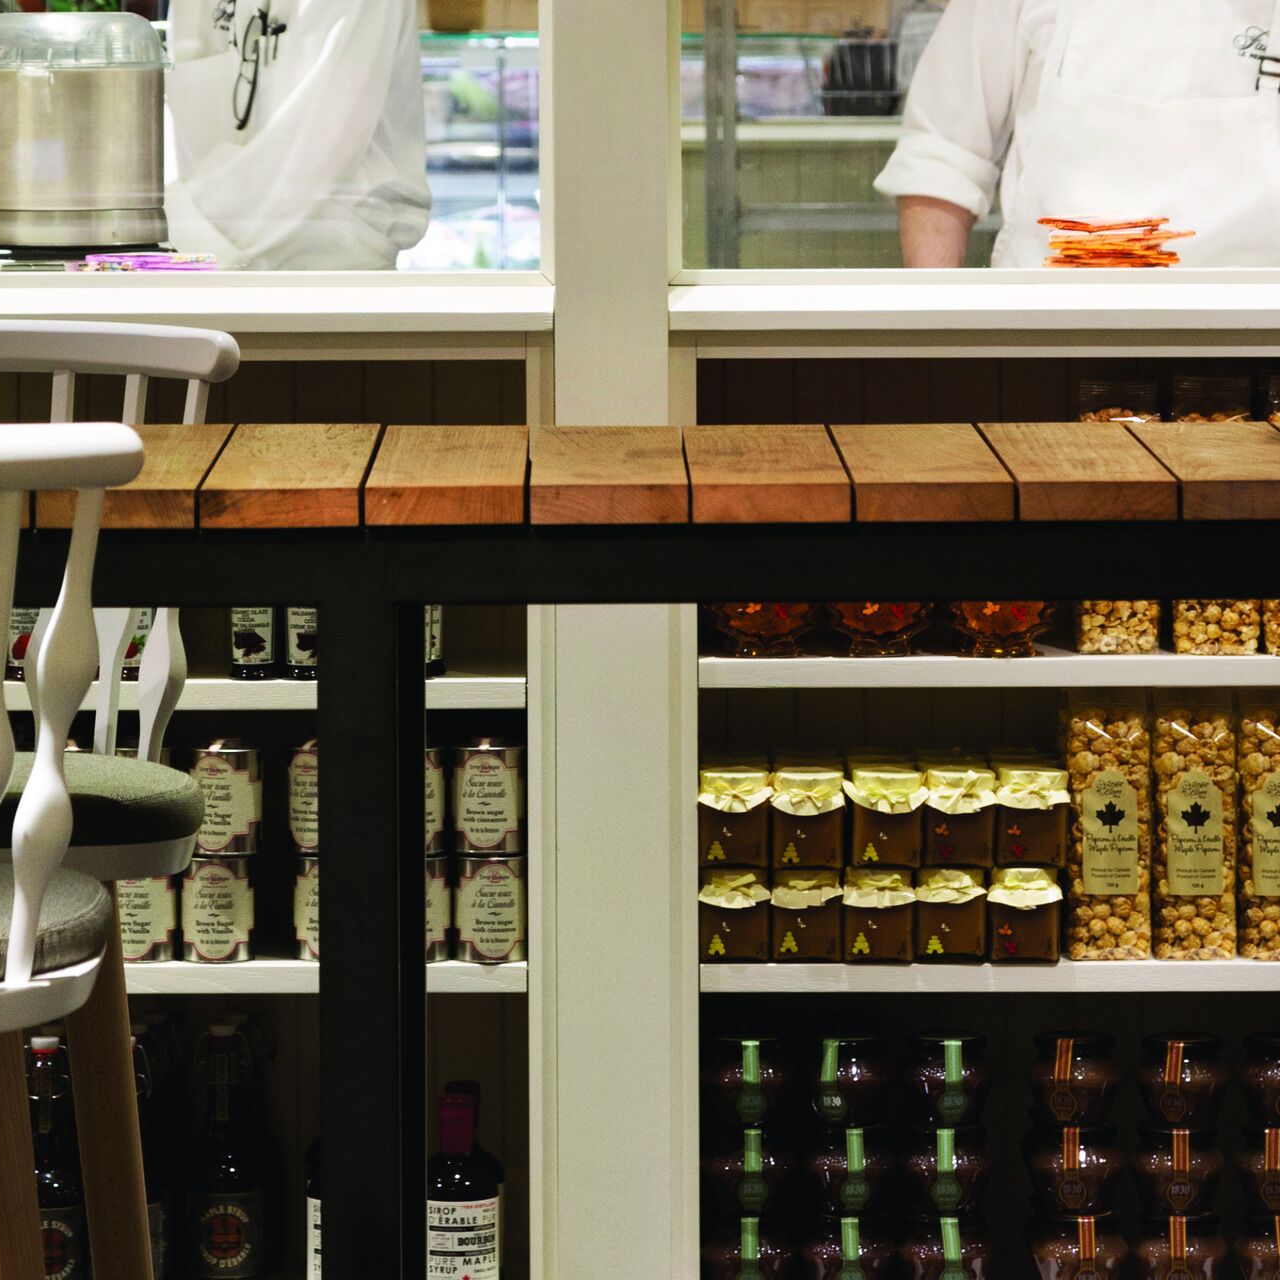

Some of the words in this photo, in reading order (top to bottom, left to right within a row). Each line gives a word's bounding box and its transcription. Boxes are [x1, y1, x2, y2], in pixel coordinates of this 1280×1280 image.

[214, 812, 232, 820] Sugar
[132, 920, 151, 928] Sugar
[823, 1096, 841, 1107] 1830
[227, 1205, 250, 1223] SYRUP
[428, 1207, 456, 1216] SIROP
[428, 1257, 456, 1266] PURE
[462, 1253, 496, 1266] MAPLE
[428, 1265, 458, 1274] SYRUP
